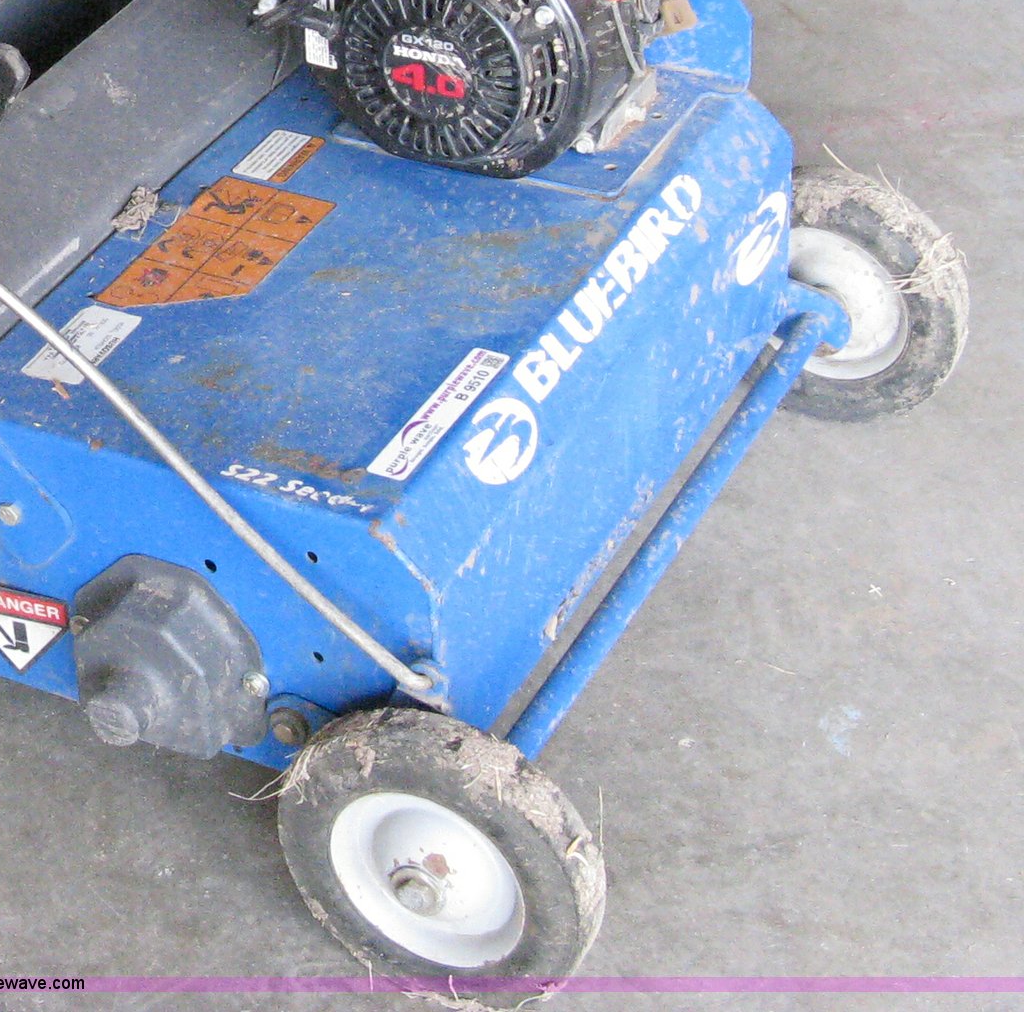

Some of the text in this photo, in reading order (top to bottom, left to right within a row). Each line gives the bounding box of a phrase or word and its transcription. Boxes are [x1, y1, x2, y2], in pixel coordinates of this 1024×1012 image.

[392, 45, 467, 69] HONDA
[401, 34, 455, 52] GX120
[390, 62, 465, 99] 4.0
[513, 174, 702, 404] BLUEBIRD
[419, 350, 488, 421] www.purplewave.com
[454, 370, 490, 402] B 9510
[386, 445, 412, 474] purple
[410, 423, 432, 445] wave
[220, 464, 279, 486] S22
